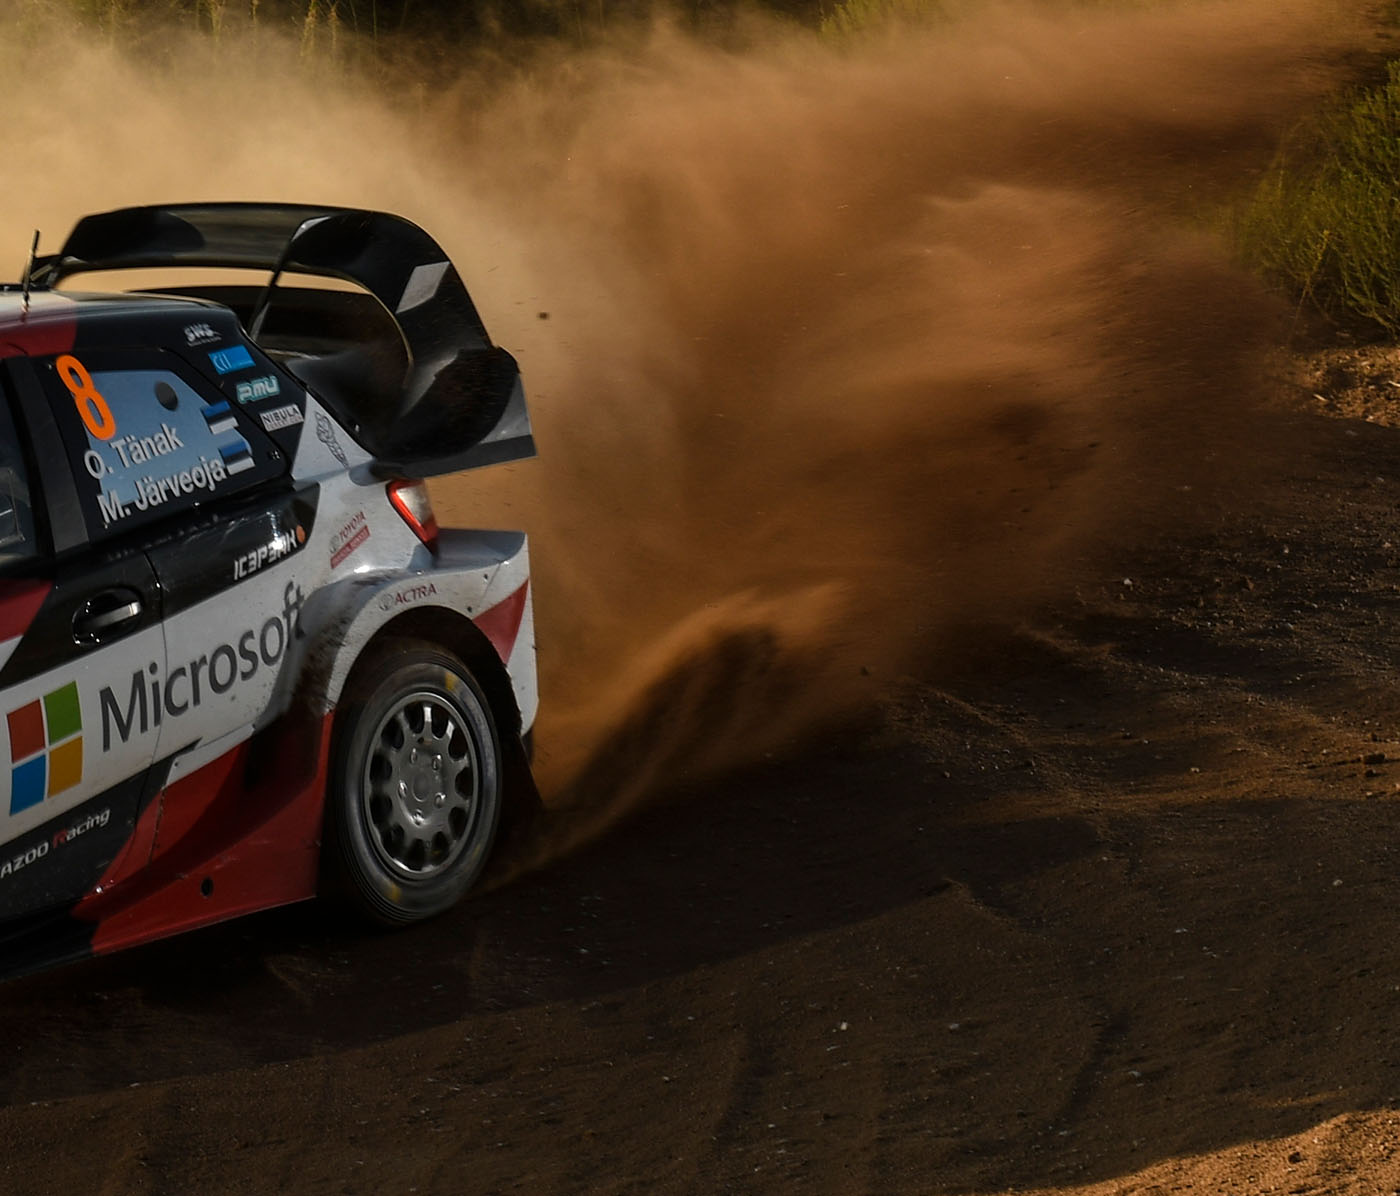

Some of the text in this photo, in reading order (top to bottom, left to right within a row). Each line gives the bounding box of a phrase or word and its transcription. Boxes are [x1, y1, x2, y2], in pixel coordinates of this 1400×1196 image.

[56, 355, 116, 441] 8
[84, 423, 184, 480] O. Tänak
[97, 456, 227, 524] M. Järveoja
[100, 580, 306, 752] Microsoft
[53, 808, 110, 849] Racing
